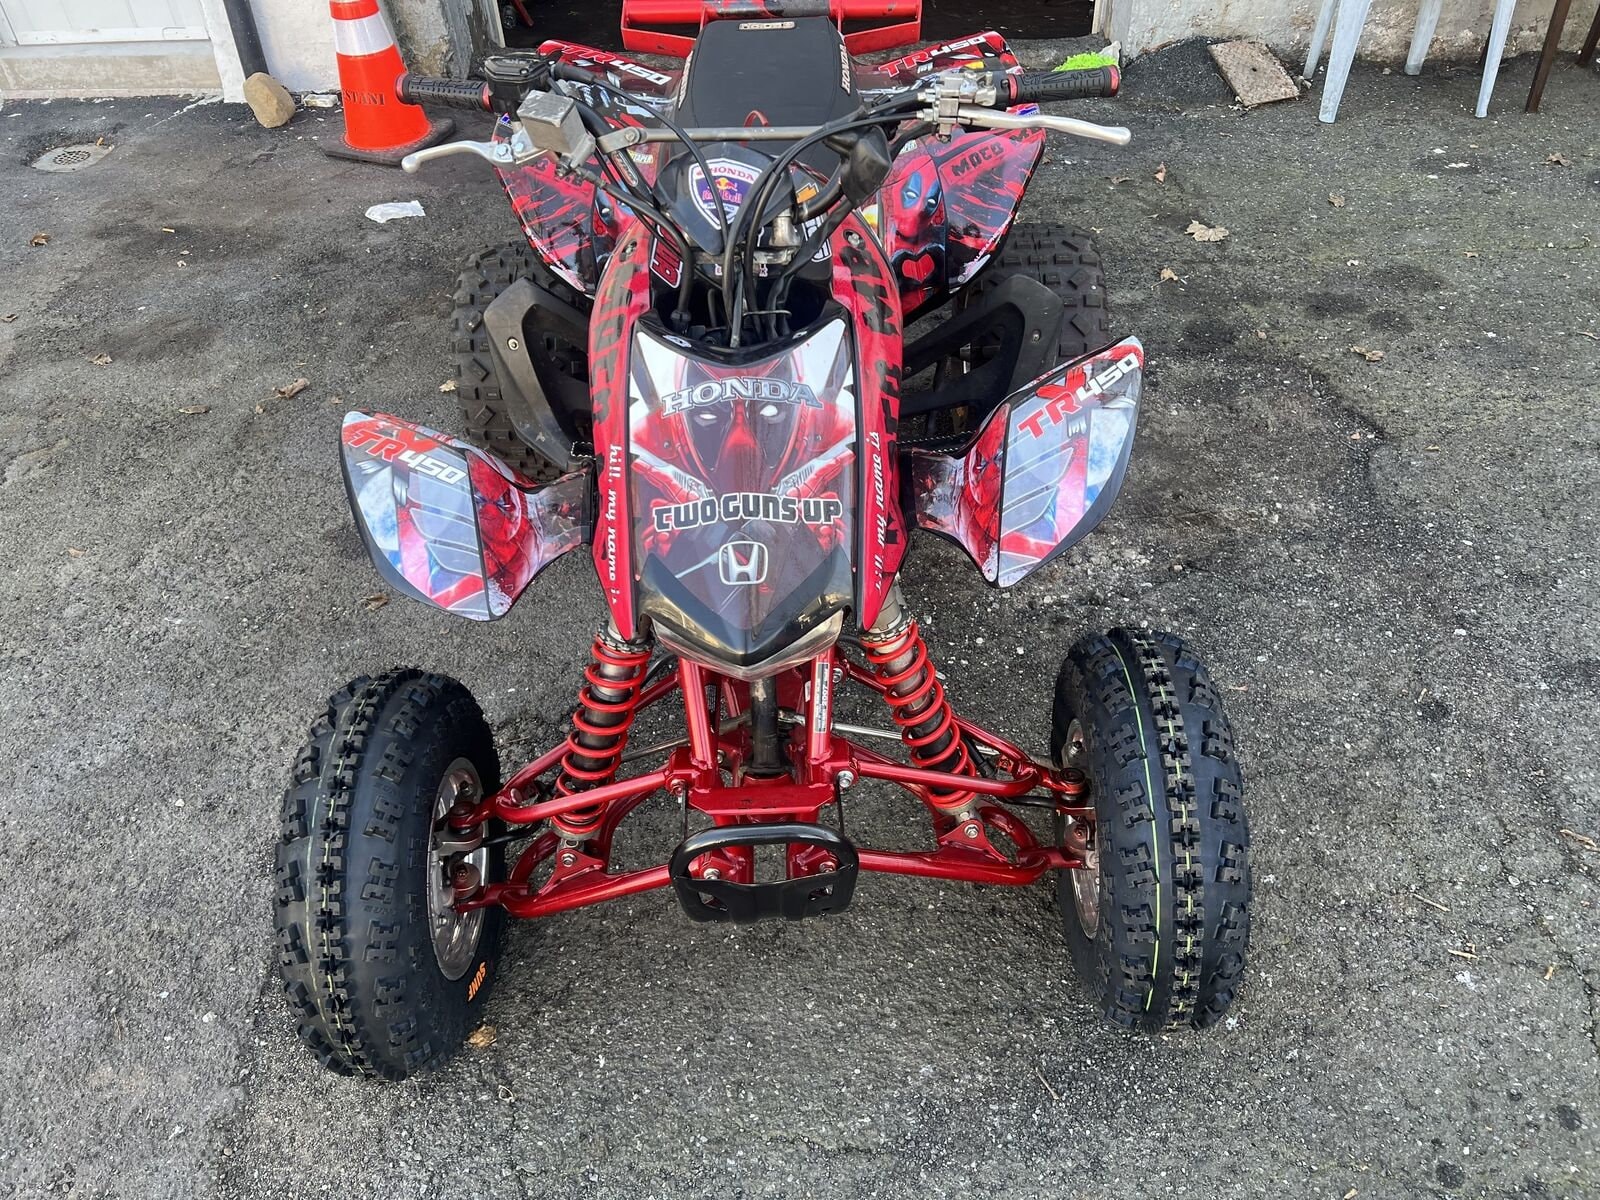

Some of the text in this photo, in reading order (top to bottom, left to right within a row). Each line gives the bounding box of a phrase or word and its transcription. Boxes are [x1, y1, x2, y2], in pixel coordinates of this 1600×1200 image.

[661, 376, 823, 418] HONDA
[866, 432, 880, 451] is
[873, 453, 884, 511] name
[605, 488, 616, 521] my
[720, 492, 799, 523] GUNS
[801, 497, 842, 525] UP
